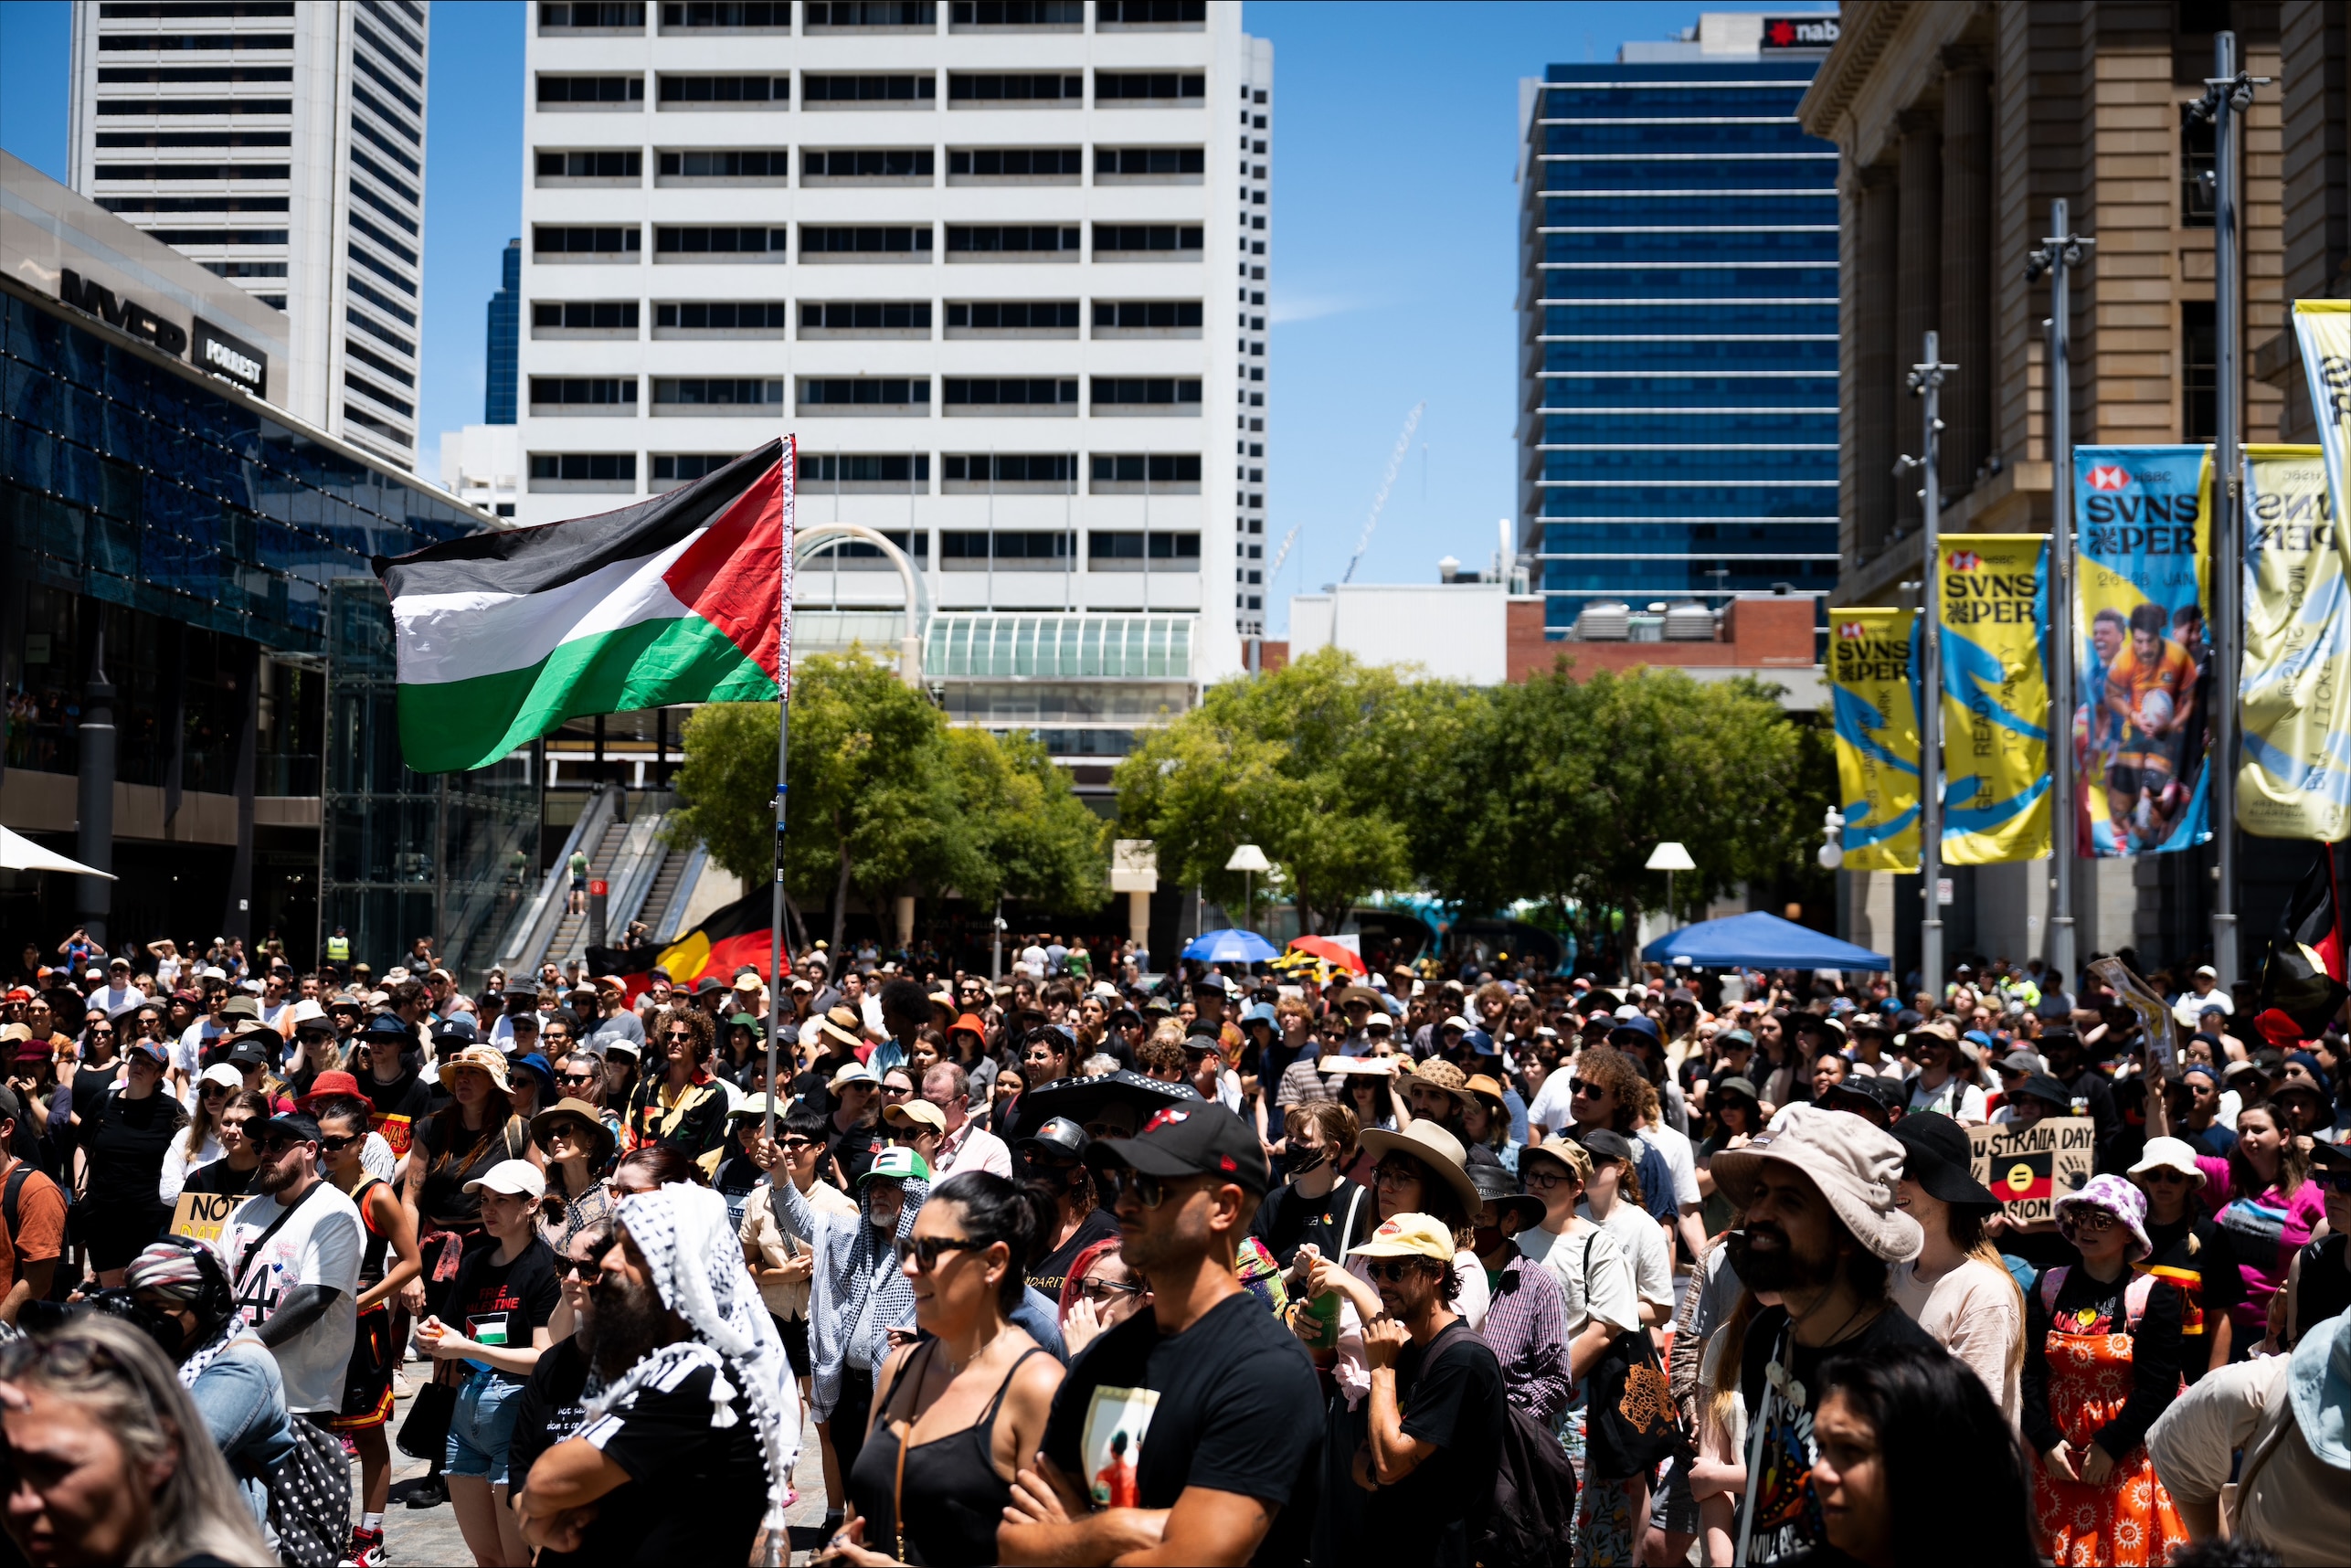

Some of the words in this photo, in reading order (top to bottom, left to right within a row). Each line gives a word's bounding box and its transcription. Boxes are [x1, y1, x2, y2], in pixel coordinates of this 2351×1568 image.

[1795, 20, 1840, 41] nab
[60, 268, 187, 357] MYER
[206, 338, 262, 384] FORREST
[2134, 471, 2172, 483] HSBC
[2086, 494, 2199, 524] SVNS
[2119, 526, 2199, 555] PER
[1945, 574, 2039, 599] SVNS
[1972, 600, 2037, 623] PER
[1836, 641, 1911, 661] SVNS
[1858, 662, 1911, 681] PER
[1972, 686, 1993, 758] READY
[2001, 727, 2018, 756] TO
[1975, 773, 1994, 811] GET
[1974, 1127, 2058, 1157] USTRALIA
[2061, 1127, 2093, 1150] DAY
[189, 1195, 245, 1222] NOT
[1996, 1199, 2051, 1219] SION
[180, 1224, 221, 1241] DAT
[478, 1284, 509, 1300] FREE
[465, 1297, 521, 1314] ALESTINE
